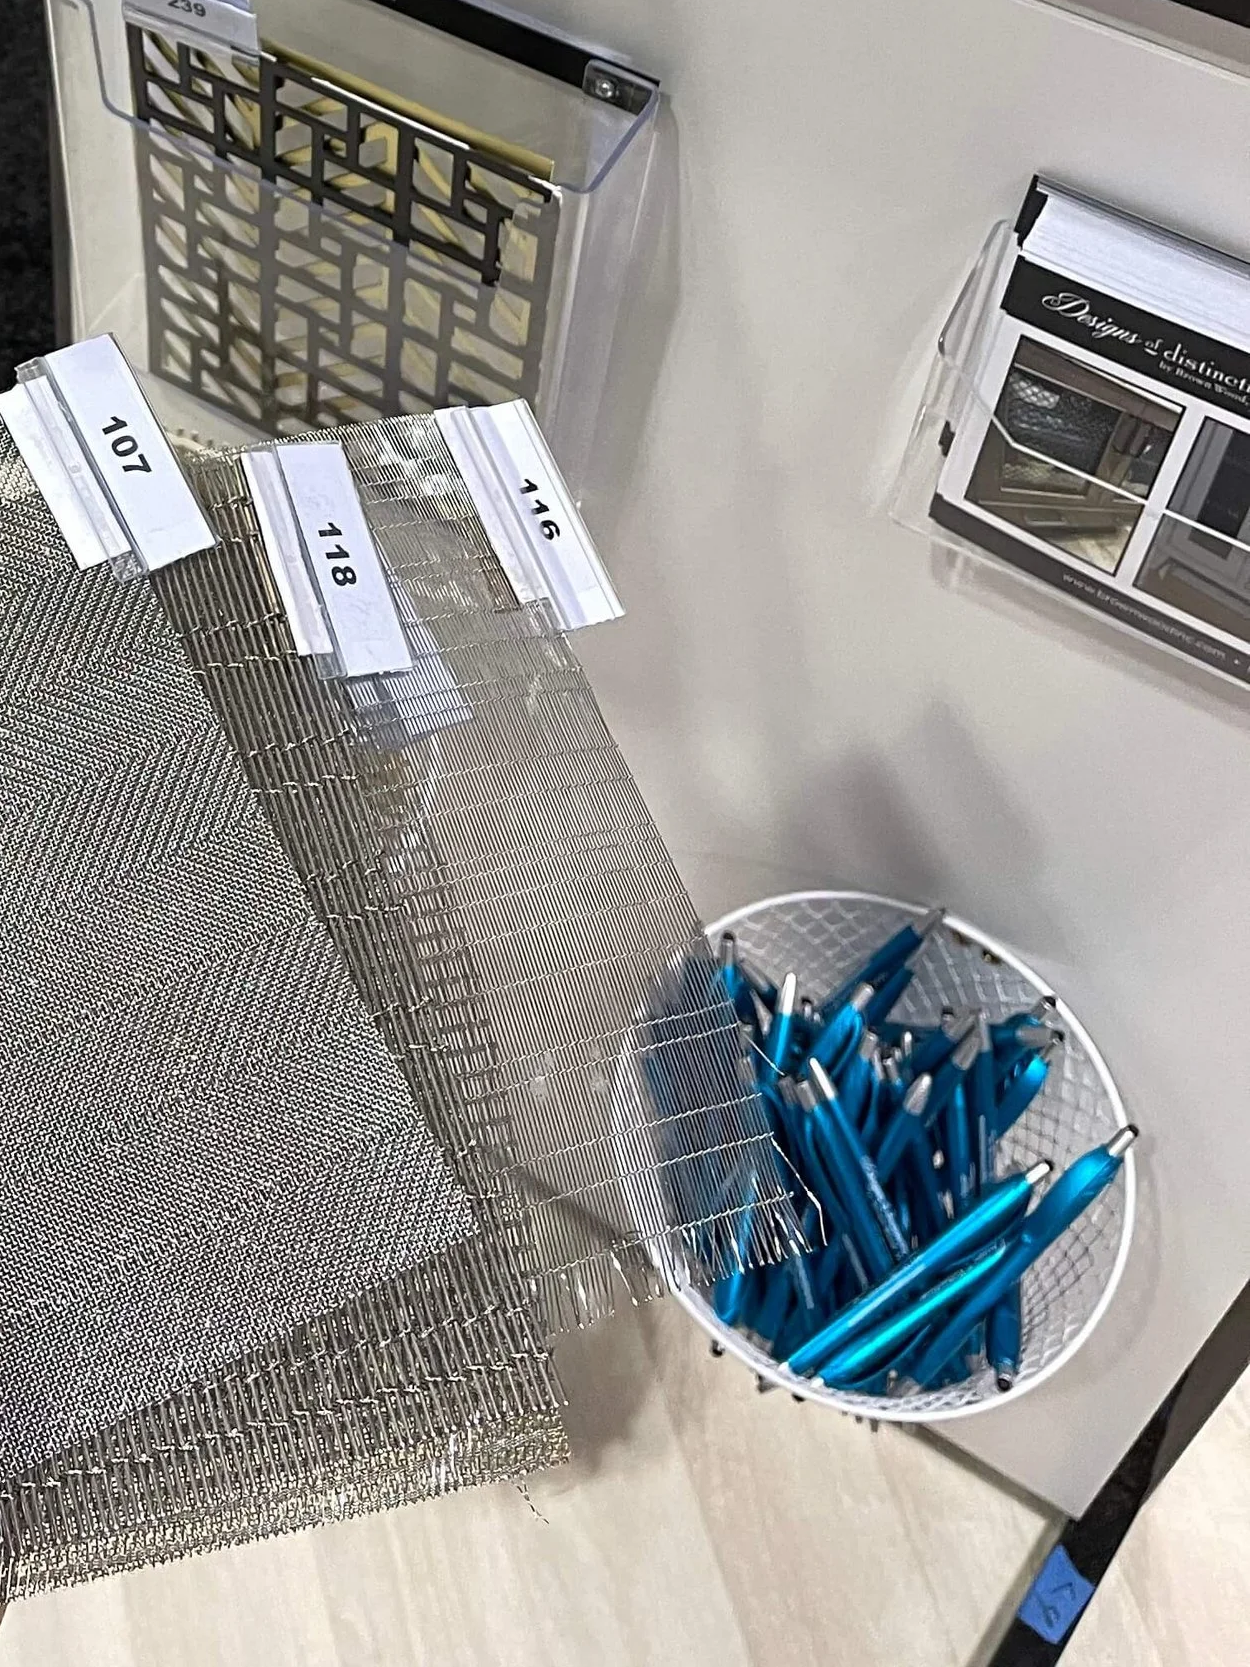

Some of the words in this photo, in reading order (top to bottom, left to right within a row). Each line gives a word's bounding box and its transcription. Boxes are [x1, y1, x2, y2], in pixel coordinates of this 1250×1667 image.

[1041, 291, 1142, 345] Designs
[1144, 338, 1164, 356] of
[101, 415, 153, 473] 107
[519, 478, 561, 542] 116
[317, 521, 358, 587] 118
